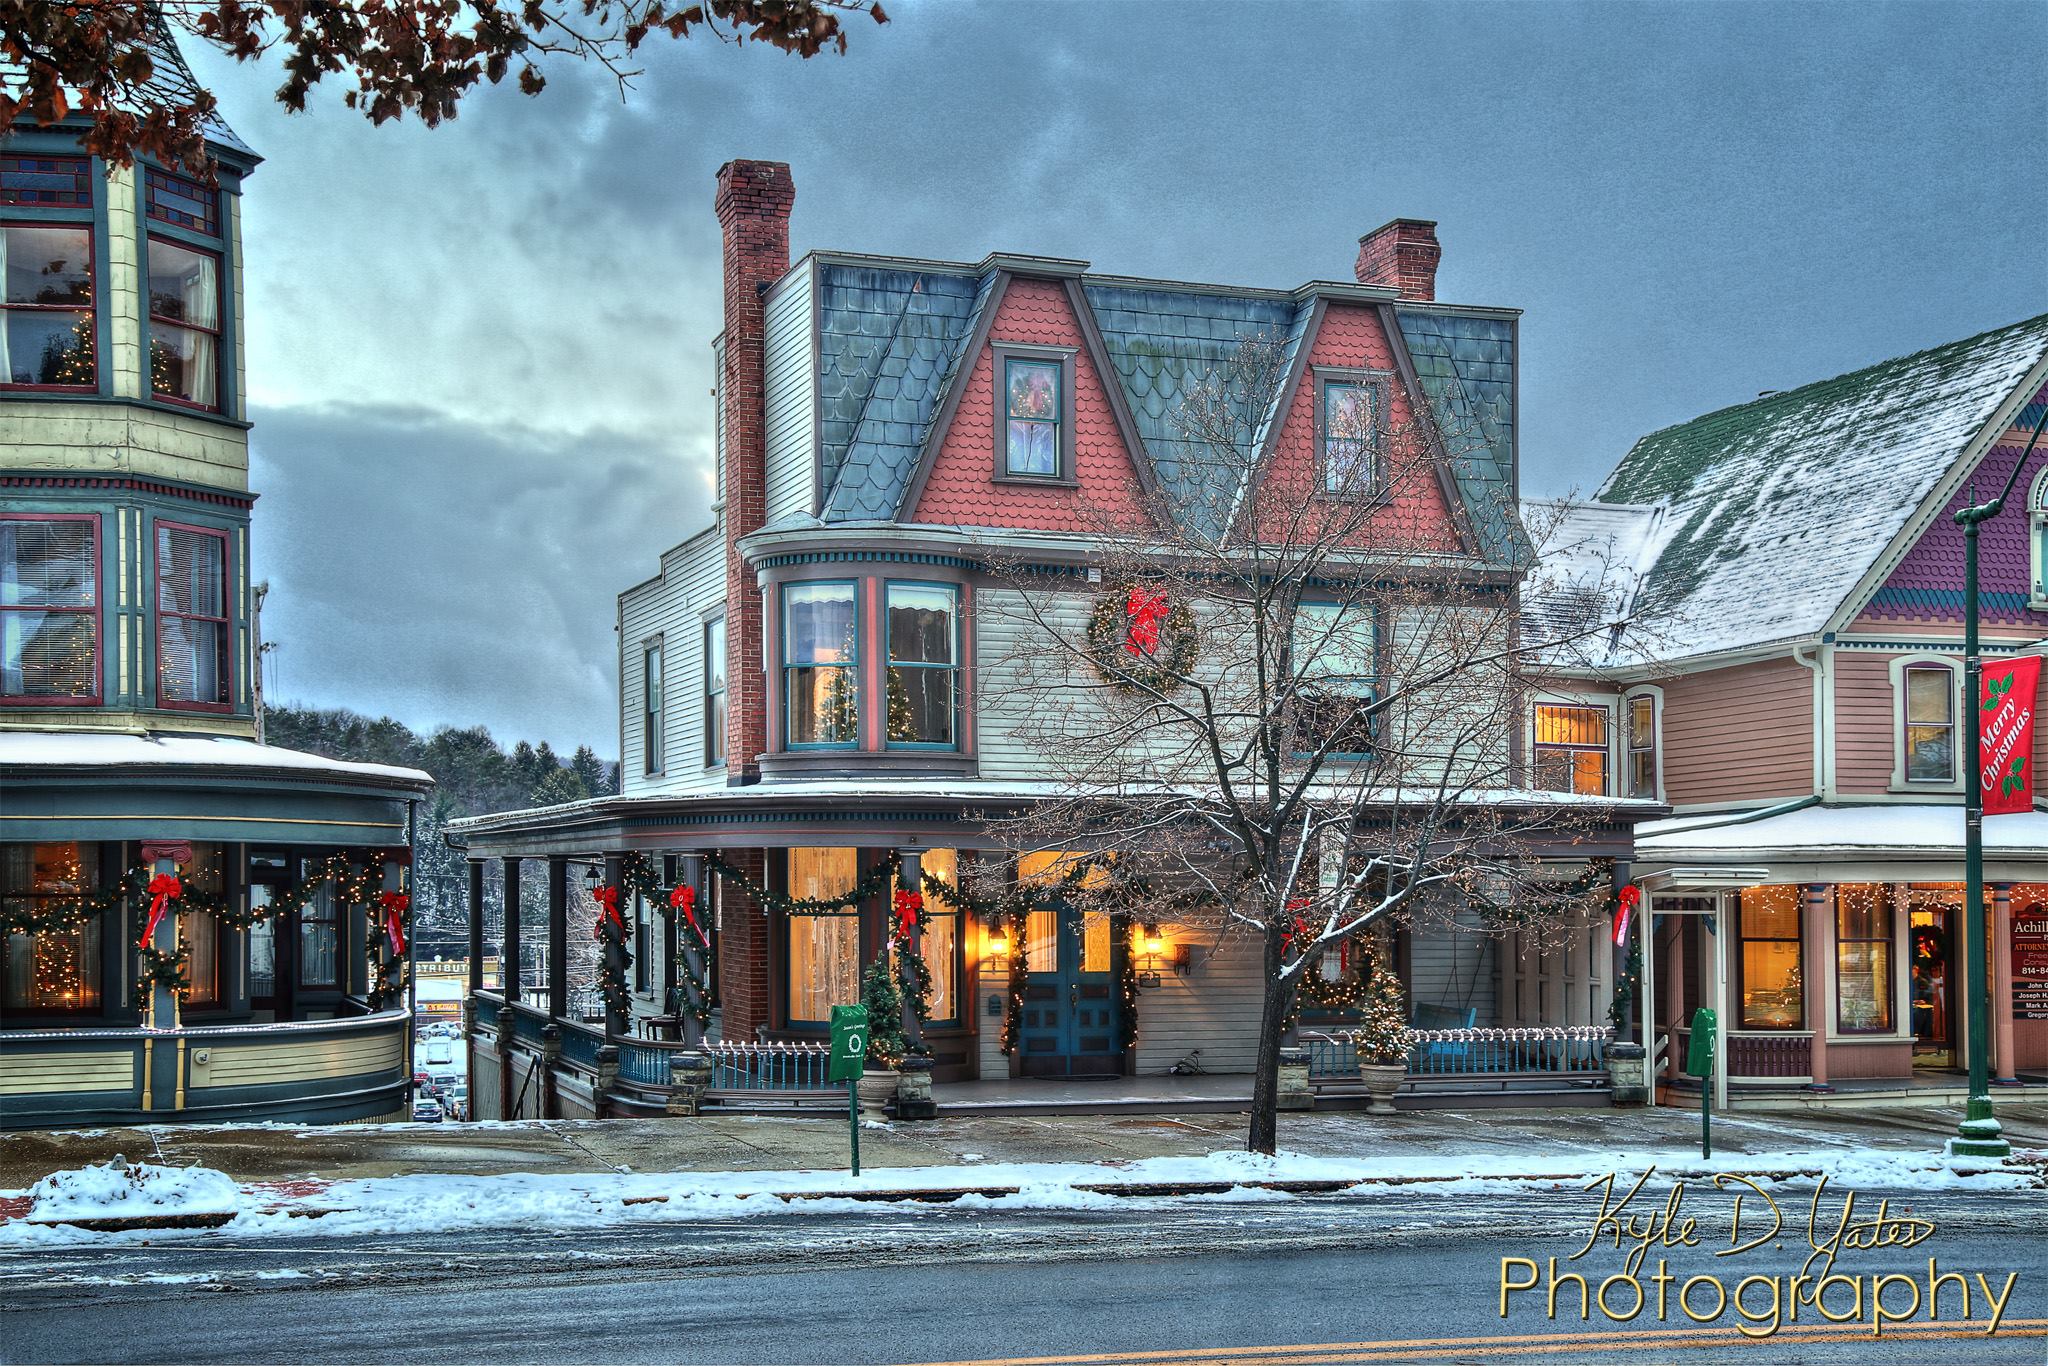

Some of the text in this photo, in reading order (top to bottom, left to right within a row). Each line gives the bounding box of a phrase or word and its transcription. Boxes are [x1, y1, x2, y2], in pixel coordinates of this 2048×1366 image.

[1980, 697, 2015, 754] Merry
[1981, 707, 2031, 791] Christmas
[2018, 992, 2041, 1000] Joseph
